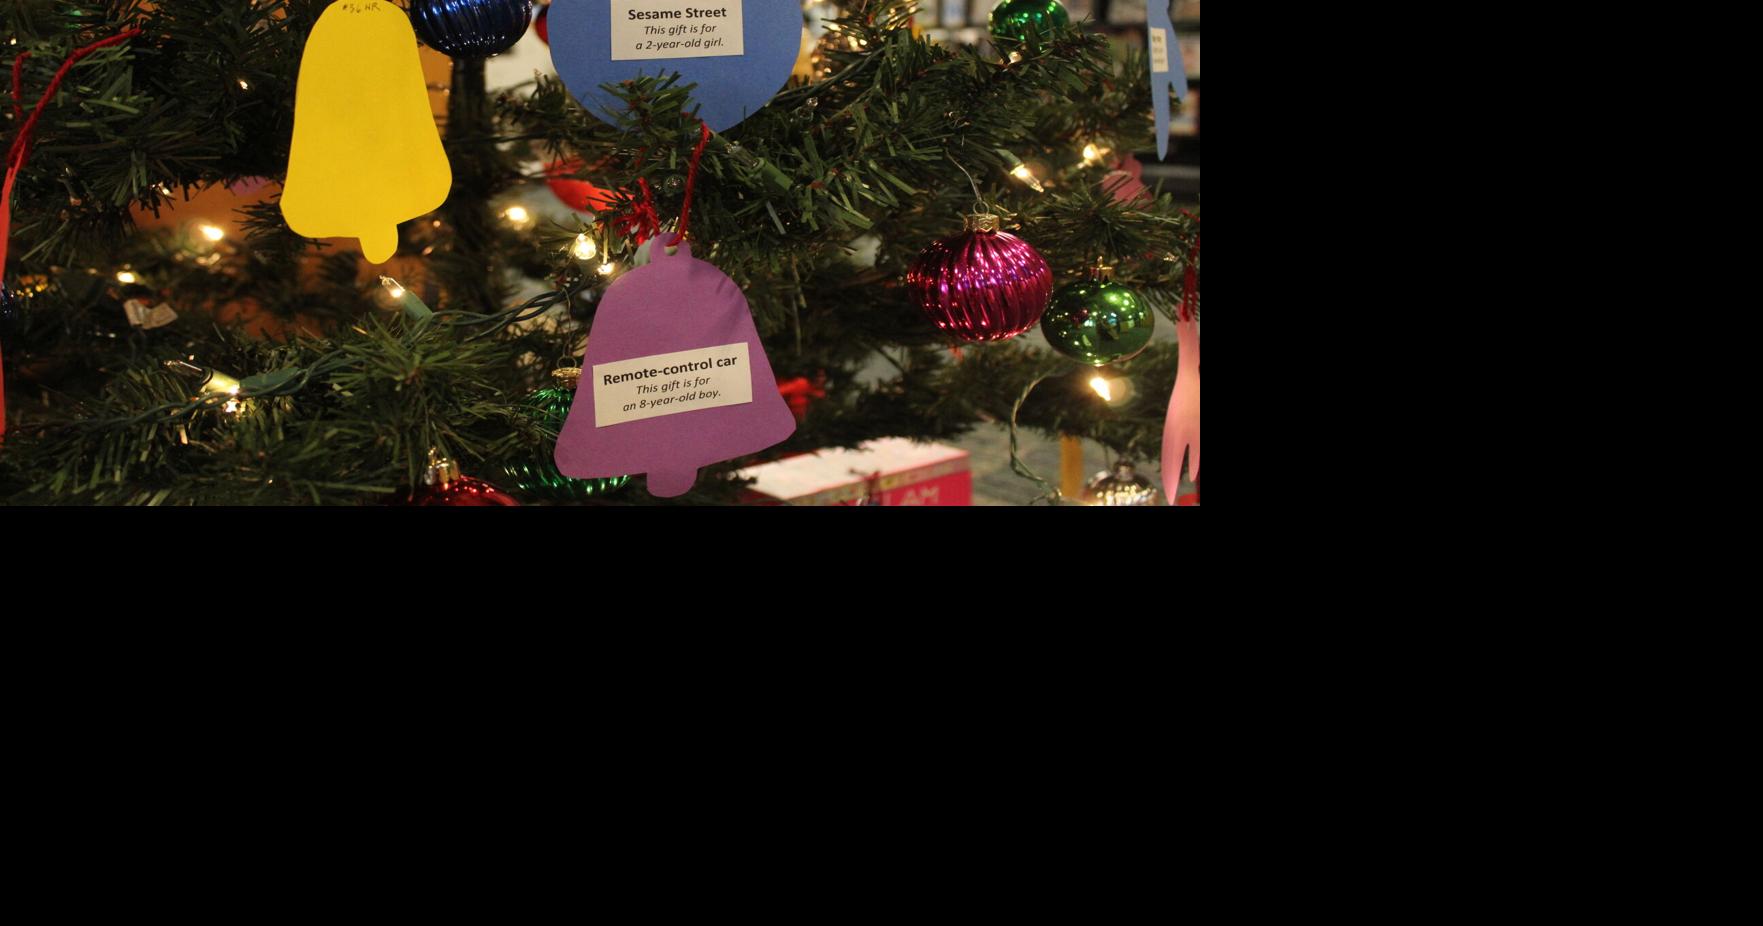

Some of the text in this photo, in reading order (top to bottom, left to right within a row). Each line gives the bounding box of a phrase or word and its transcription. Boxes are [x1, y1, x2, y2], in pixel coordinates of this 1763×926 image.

[628, 7, 727, 20] Sesame Street
[644, 24, 717, 36] This gift is for
[645, 39, 702, 51] 2-year-old
[704, 37, 724, 49] girl.
[603, 355, 738, 386] Remote-control car
[636, 375, 711, 396] This gift is for
[622, 389, 721, 412] an 8-year-old boy.
